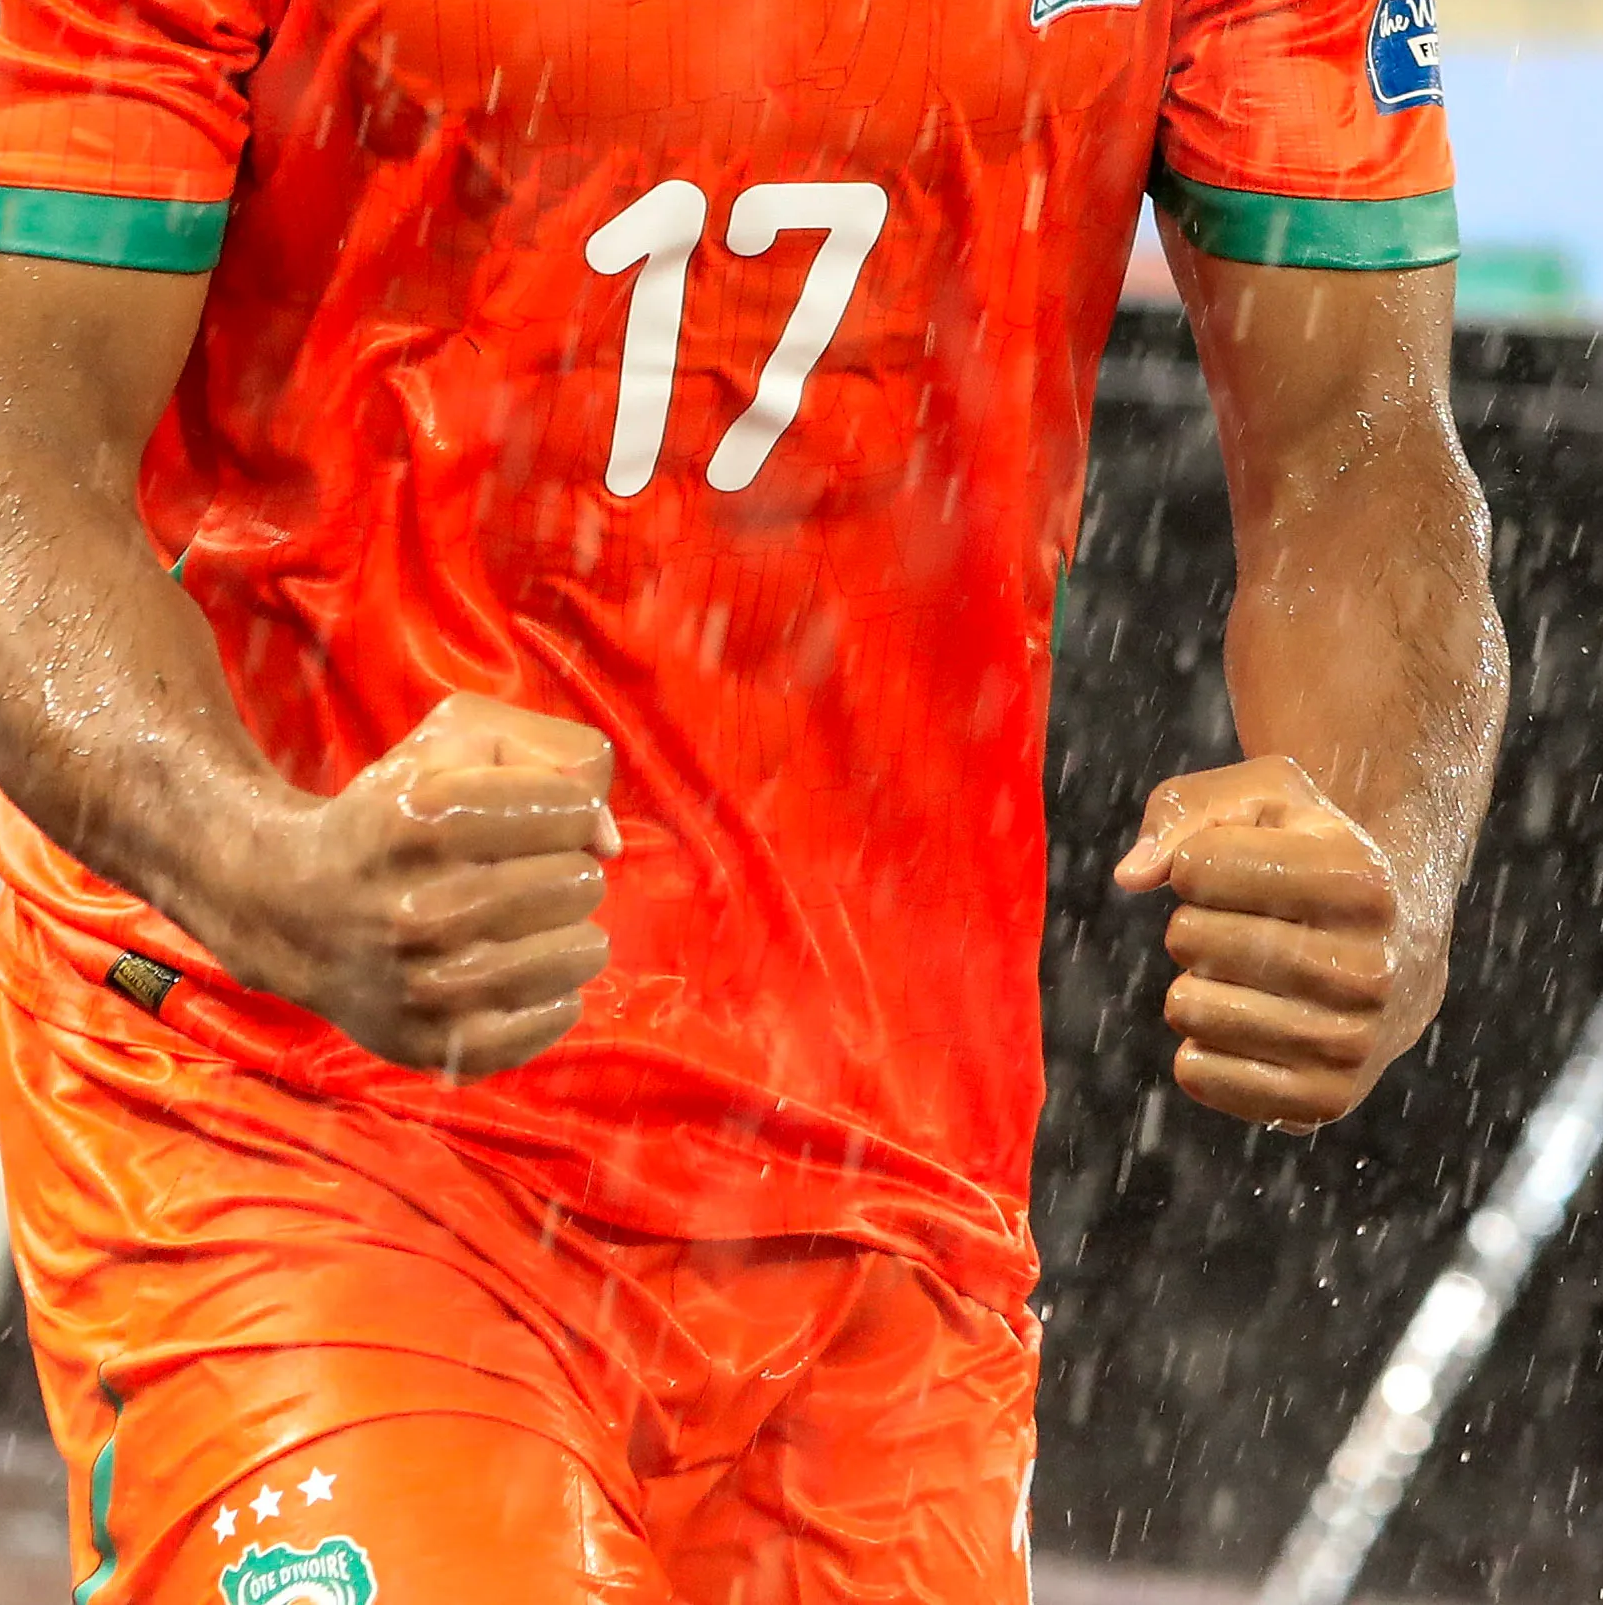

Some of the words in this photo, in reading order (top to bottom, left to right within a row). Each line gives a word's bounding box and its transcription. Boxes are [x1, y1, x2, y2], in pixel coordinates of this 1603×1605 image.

[1379, 2, 1410, 38] the
[585, 179, 890, 497] 17
[279, 1551, 350, 1586] D'IVOIRE
